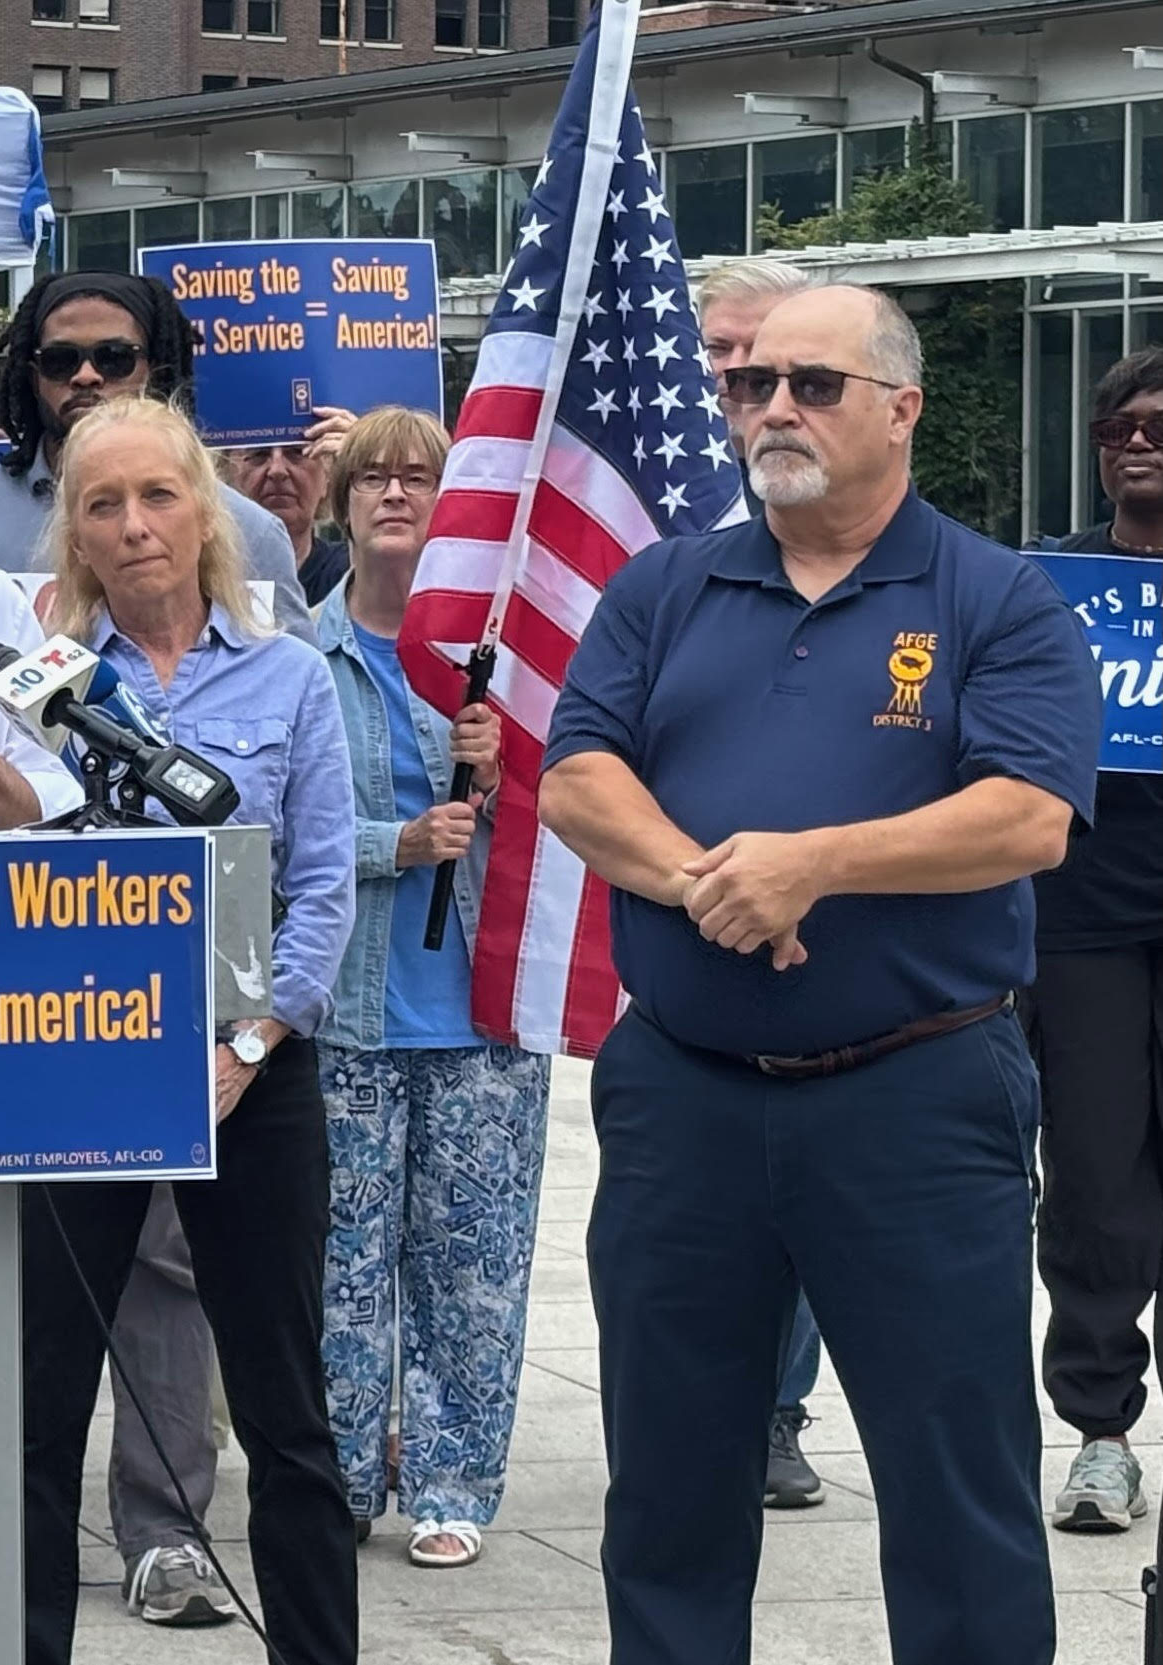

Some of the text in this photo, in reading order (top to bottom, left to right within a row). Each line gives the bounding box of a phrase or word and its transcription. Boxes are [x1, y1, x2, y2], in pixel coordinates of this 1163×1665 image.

[172, 258, 301, 304] Saving the
[332, 257, 410, 301] Saving
[213, 315, 305, 355] Service
[336, 313, 436, 350] America!
[1073, 586, 1123, 628] T'S
[893, 631, 938, 651] AFGE
[1132, 619, 1155, 637] IN
[872, 714, 923, 728] DISTRICT
[7, 860, 193, 929] Workers
[34, 1150, 113, 1167] EMPLOYEES,
[113, 1149, 164, 1163] AFL-CIO
